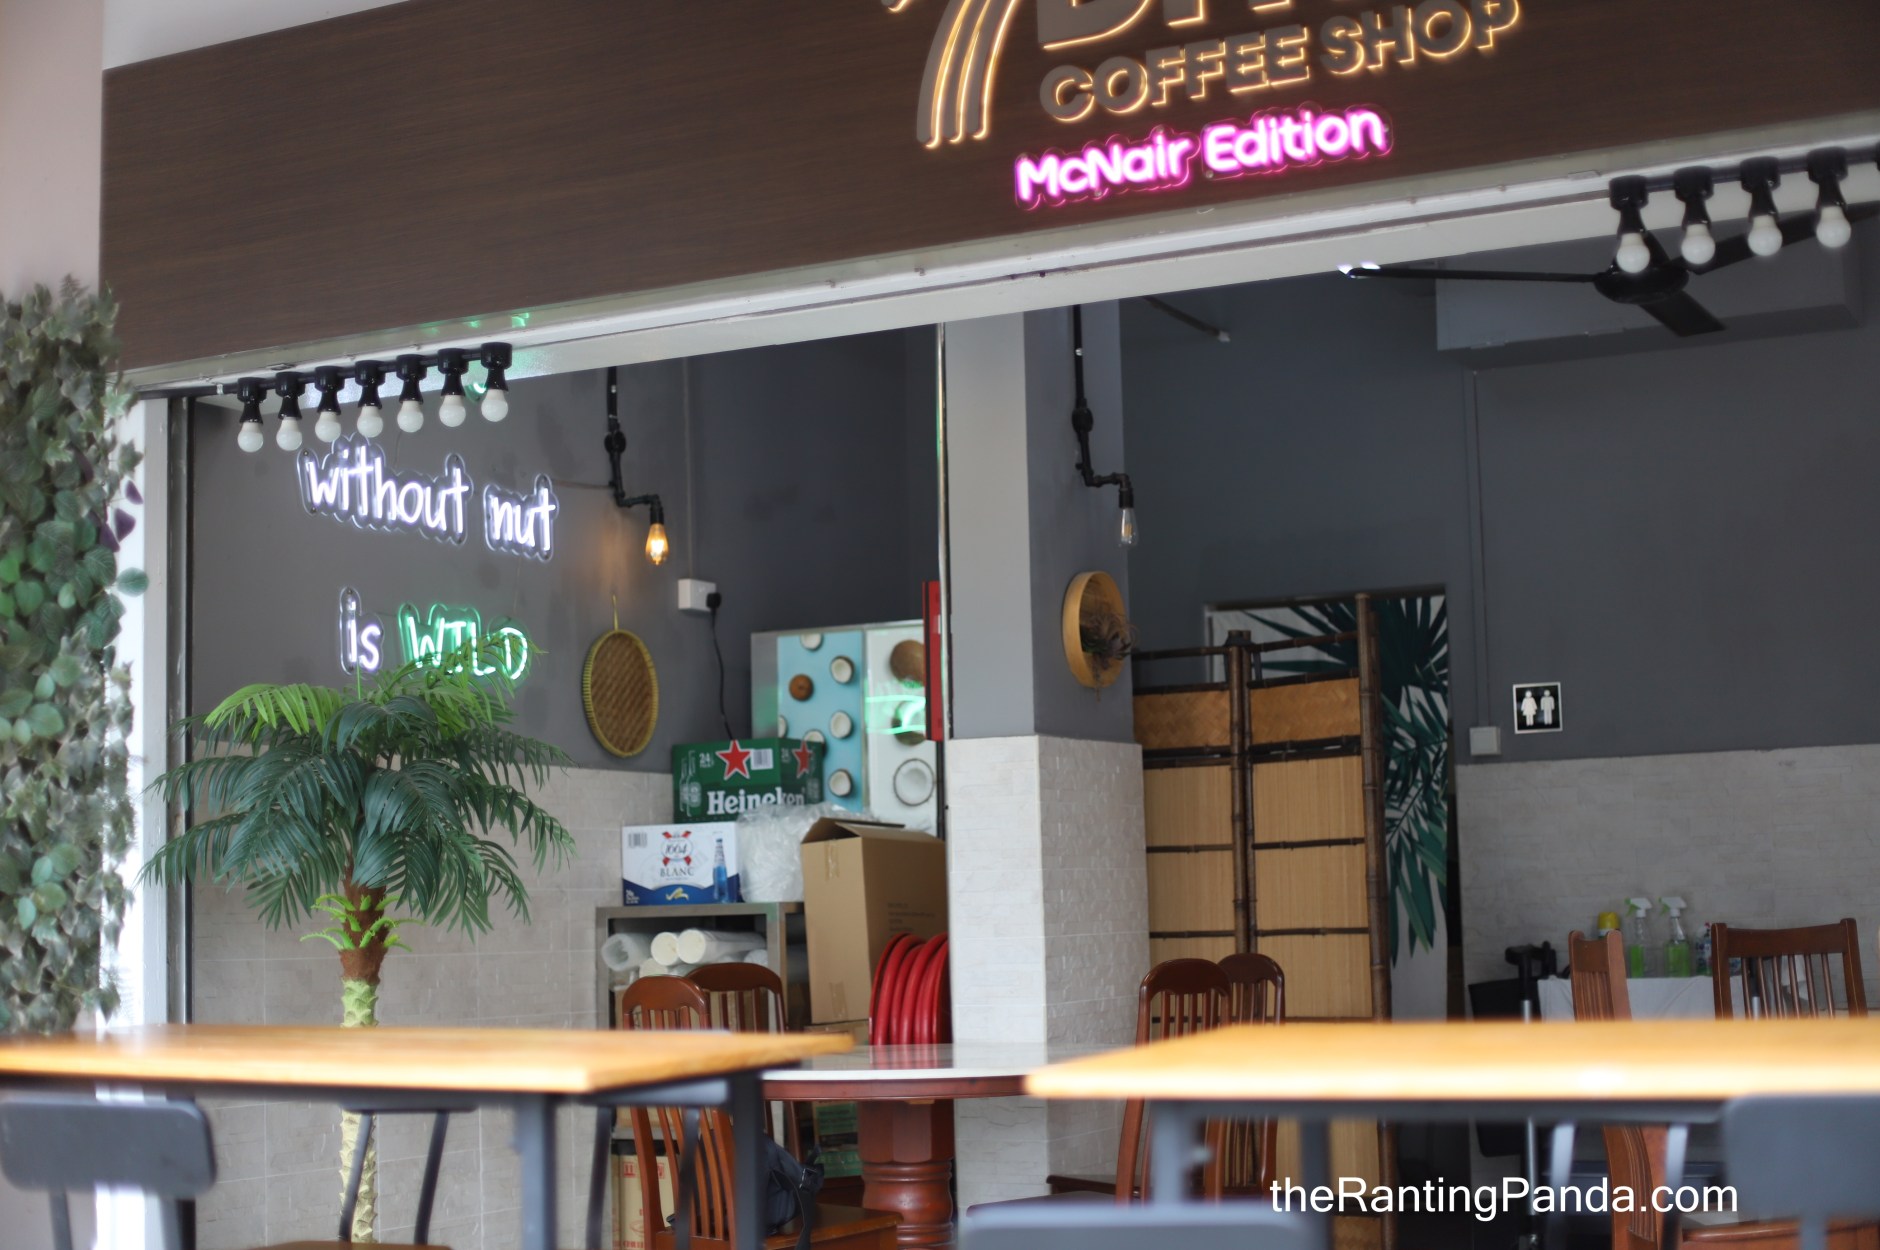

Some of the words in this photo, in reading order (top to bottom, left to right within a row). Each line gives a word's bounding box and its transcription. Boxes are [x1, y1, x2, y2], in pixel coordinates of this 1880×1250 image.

[1040, 24, 1311, 122] COFFEE
[1321, 0, 1521, 75] SHOP
[1017, 132, 1194, 203] McNair
[1202, 109, 1385, 173] Edition
[304, 444, 471, 535] without
[488, 486, 557, 552] nut
[348, 599, 382, 671] is
[407, 616, 529, 680] WILD
[659, 867, 695, 878] BLANC
